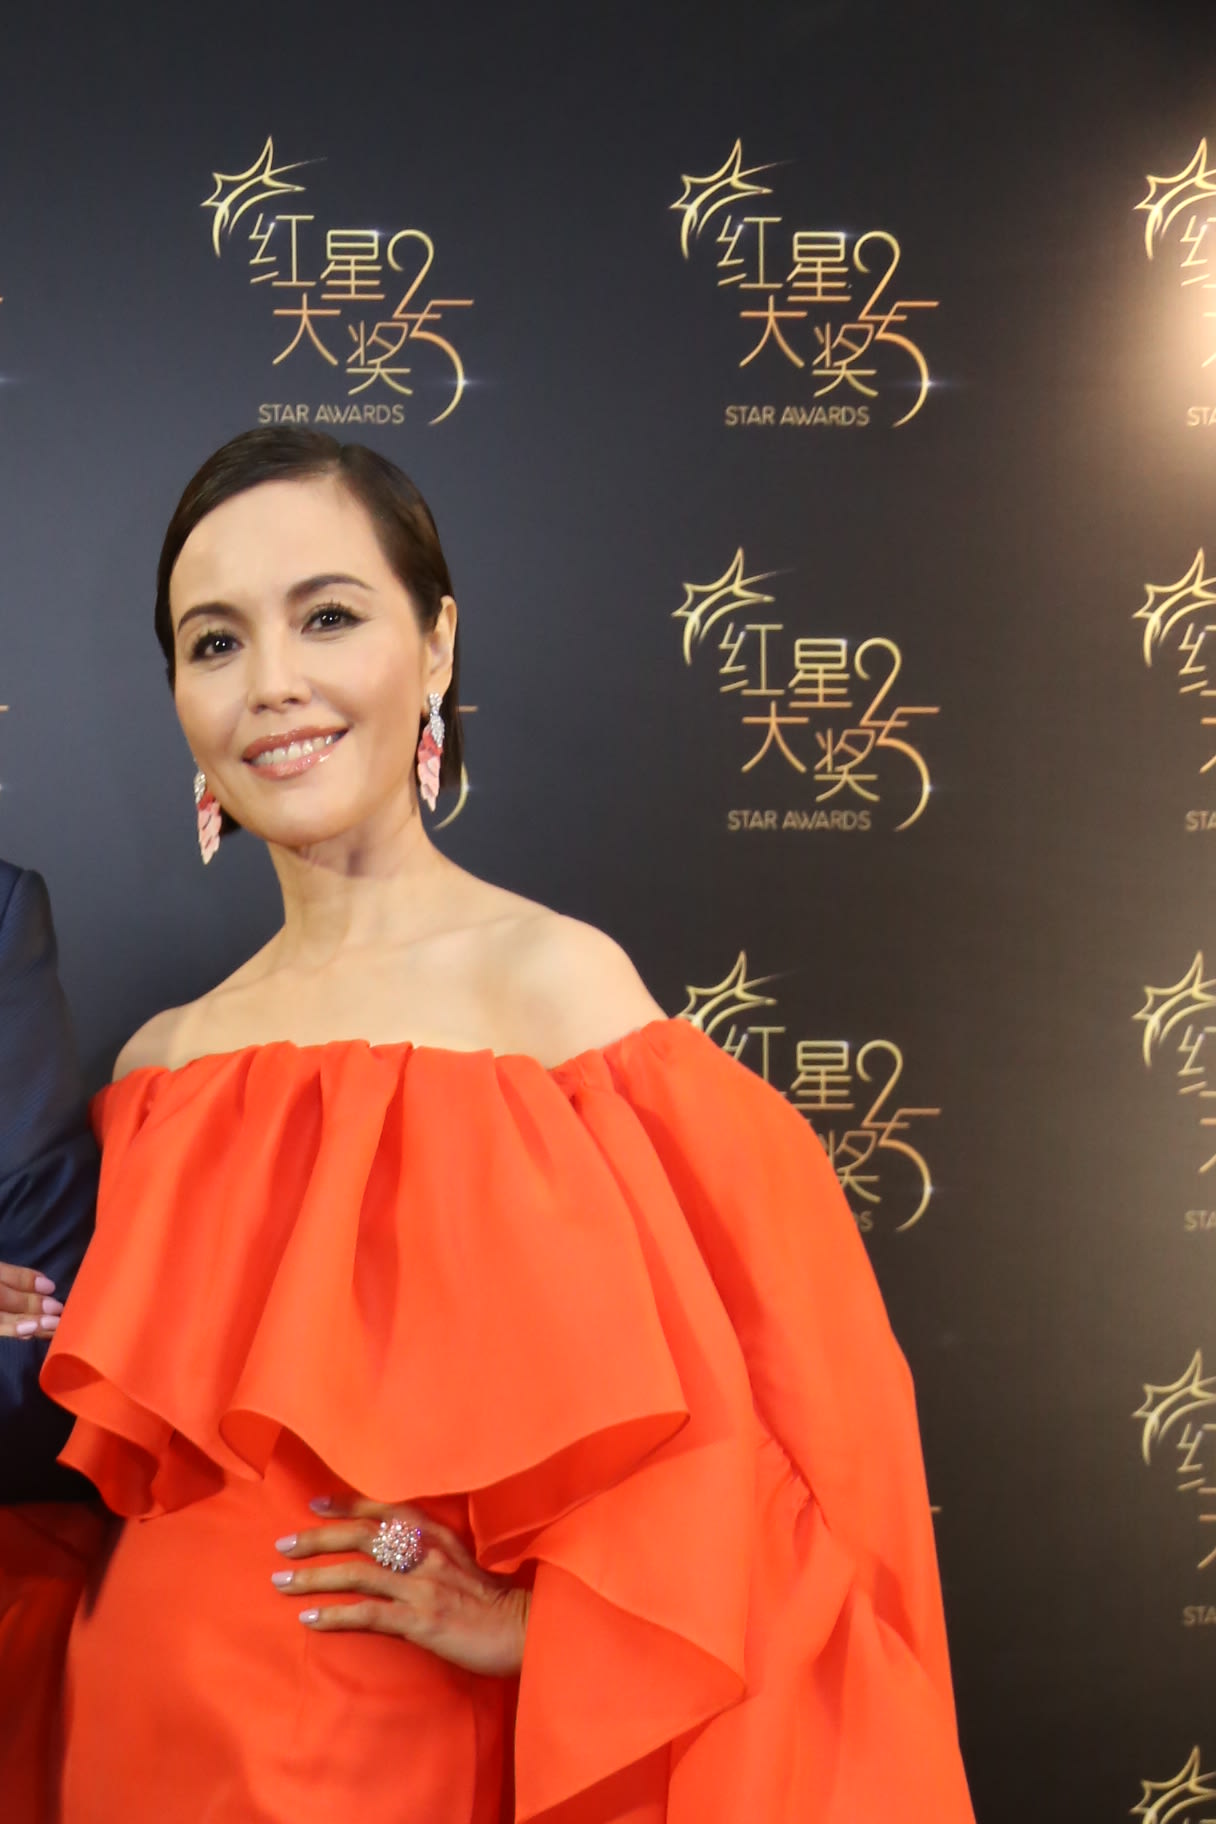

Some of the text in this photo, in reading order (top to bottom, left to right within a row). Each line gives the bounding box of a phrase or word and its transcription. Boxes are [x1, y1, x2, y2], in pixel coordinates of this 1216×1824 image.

[249, 214, 384, 299] 红星
[716, 215, 851, 301] 红星
[273, 292, 413, 395] 大奖
[739, 295, 879, 397] 大奖
[258, 404, 405, 424] STAR AWARDS
[725, 405, 870, 426] STAR AWARDS
[719, 622, 853, 708] 红星
[741, 701, 880, 803] 大奖
[727, 810, 872, 831] STAR AWARDS
[807, 1119, 882, 1203] 奖
